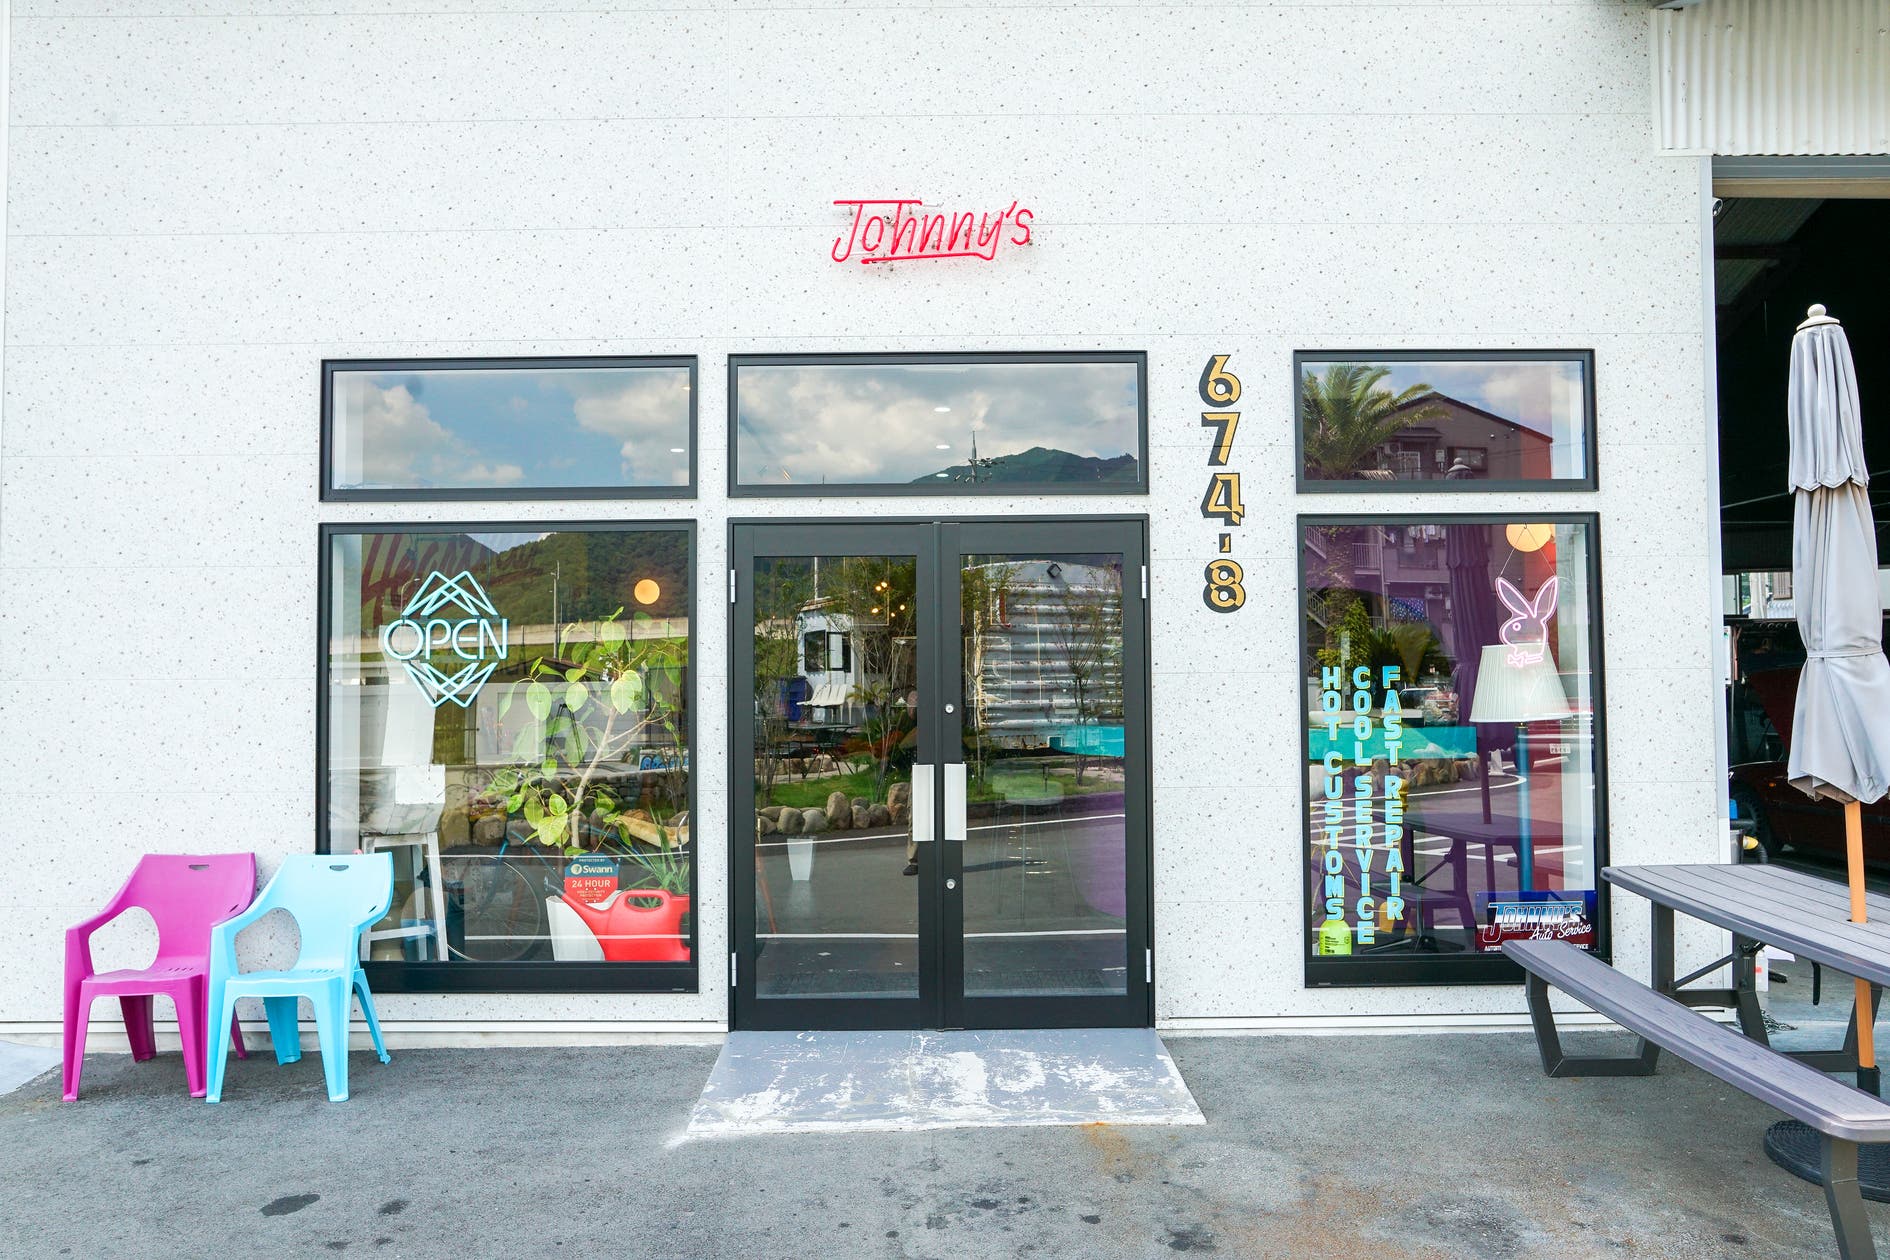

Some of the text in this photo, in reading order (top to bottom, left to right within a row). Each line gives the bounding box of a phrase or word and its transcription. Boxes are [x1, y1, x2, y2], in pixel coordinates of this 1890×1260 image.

[384, 618, 508, 661] OPEN
[1322, 666, 1342, 740] HOT
[1352, 665, 1375, 944] COOL SERVICE
[1382, 665, 1405, 920] FAST REPAIR
[1323, 750, 1345, 920] CUSTOMS
[572, 880, 610, 888] 24 HOUR
[583, 865, 613, 873] Swann
[1529, 922, 1592, 940] Auto Service
